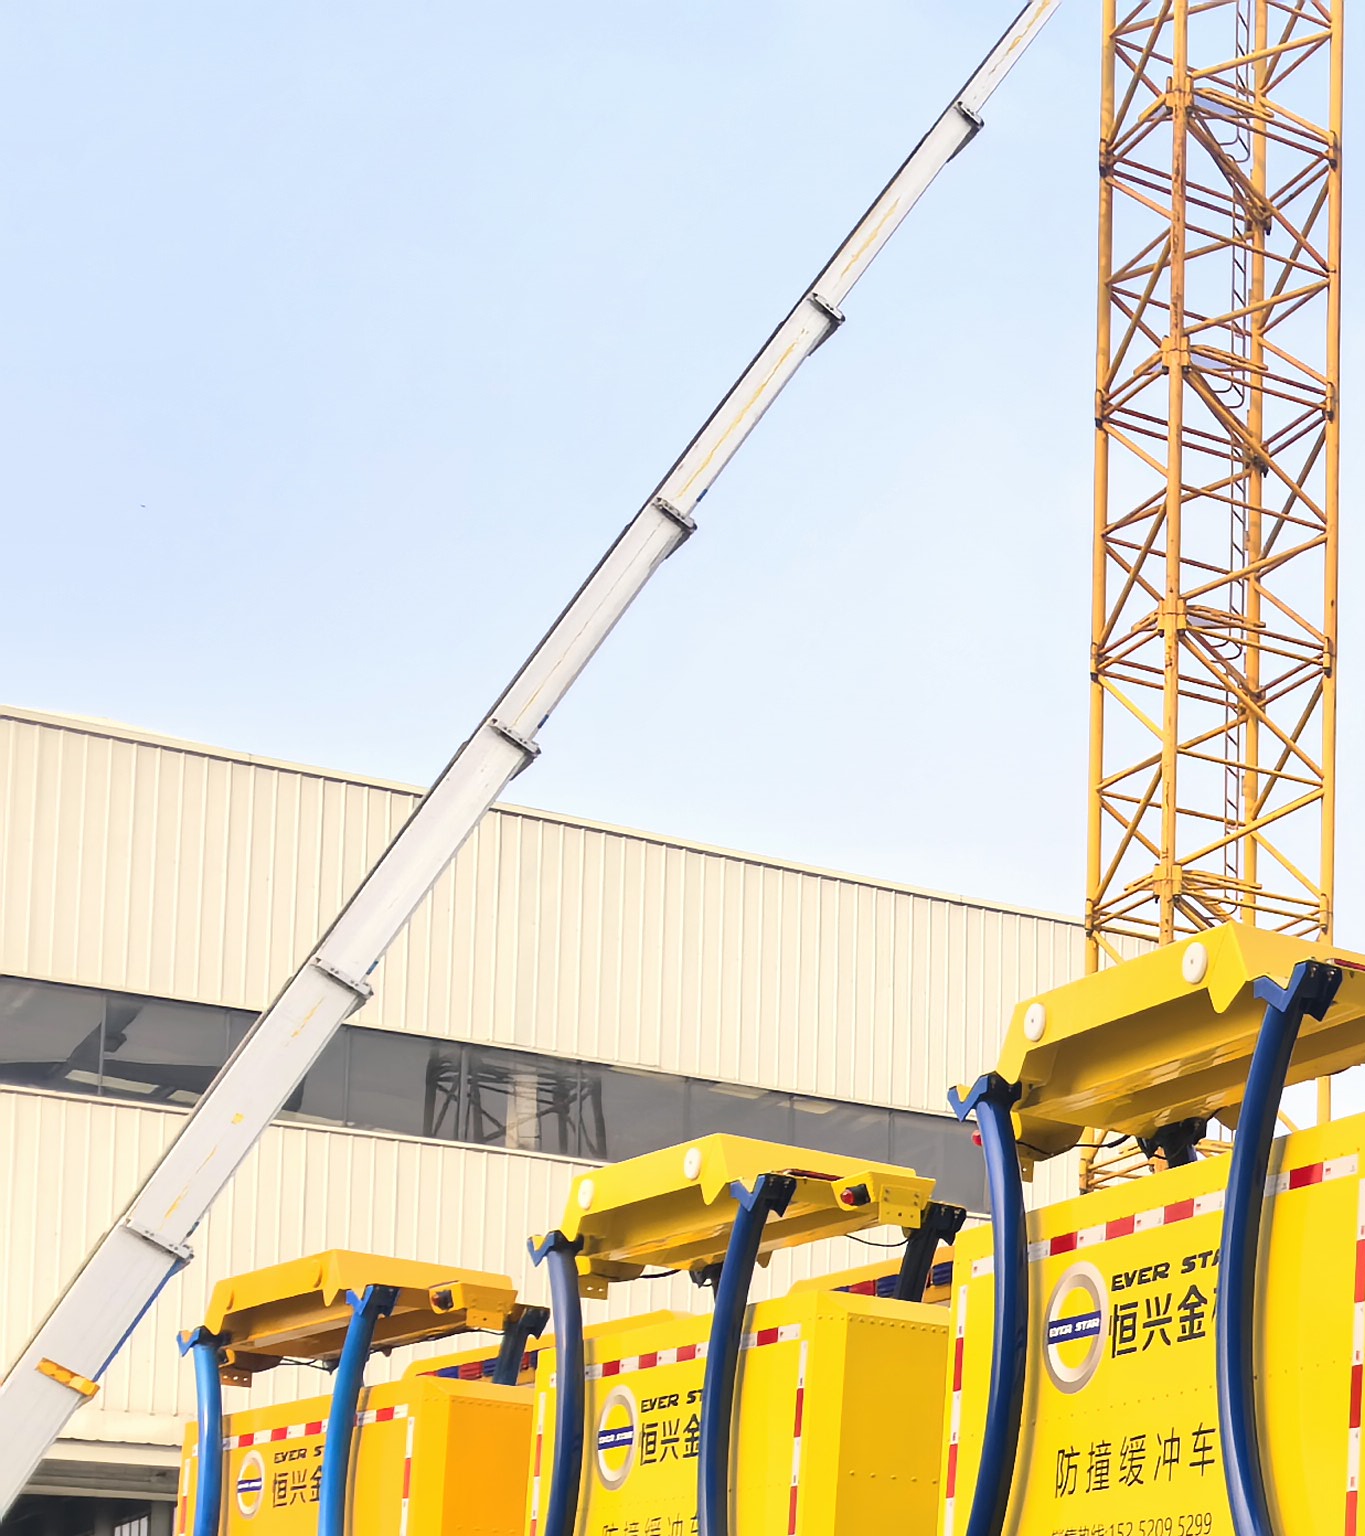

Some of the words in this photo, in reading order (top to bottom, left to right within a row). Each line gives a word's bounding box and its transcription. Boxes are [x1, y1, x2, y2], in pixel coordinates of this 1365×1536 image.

[1111, 1262, 1170, 1292] EVER
[1108, 1284, 1218, 1358] 恒兴金
[641, 1393, 678, 1413] EVER
[639, 1413, 700, 1466] 恒兴金
[1055, 1422, 1217, 1498] 防撞缓冲车
[272, 1465, 322, 1508] 恒兴金
